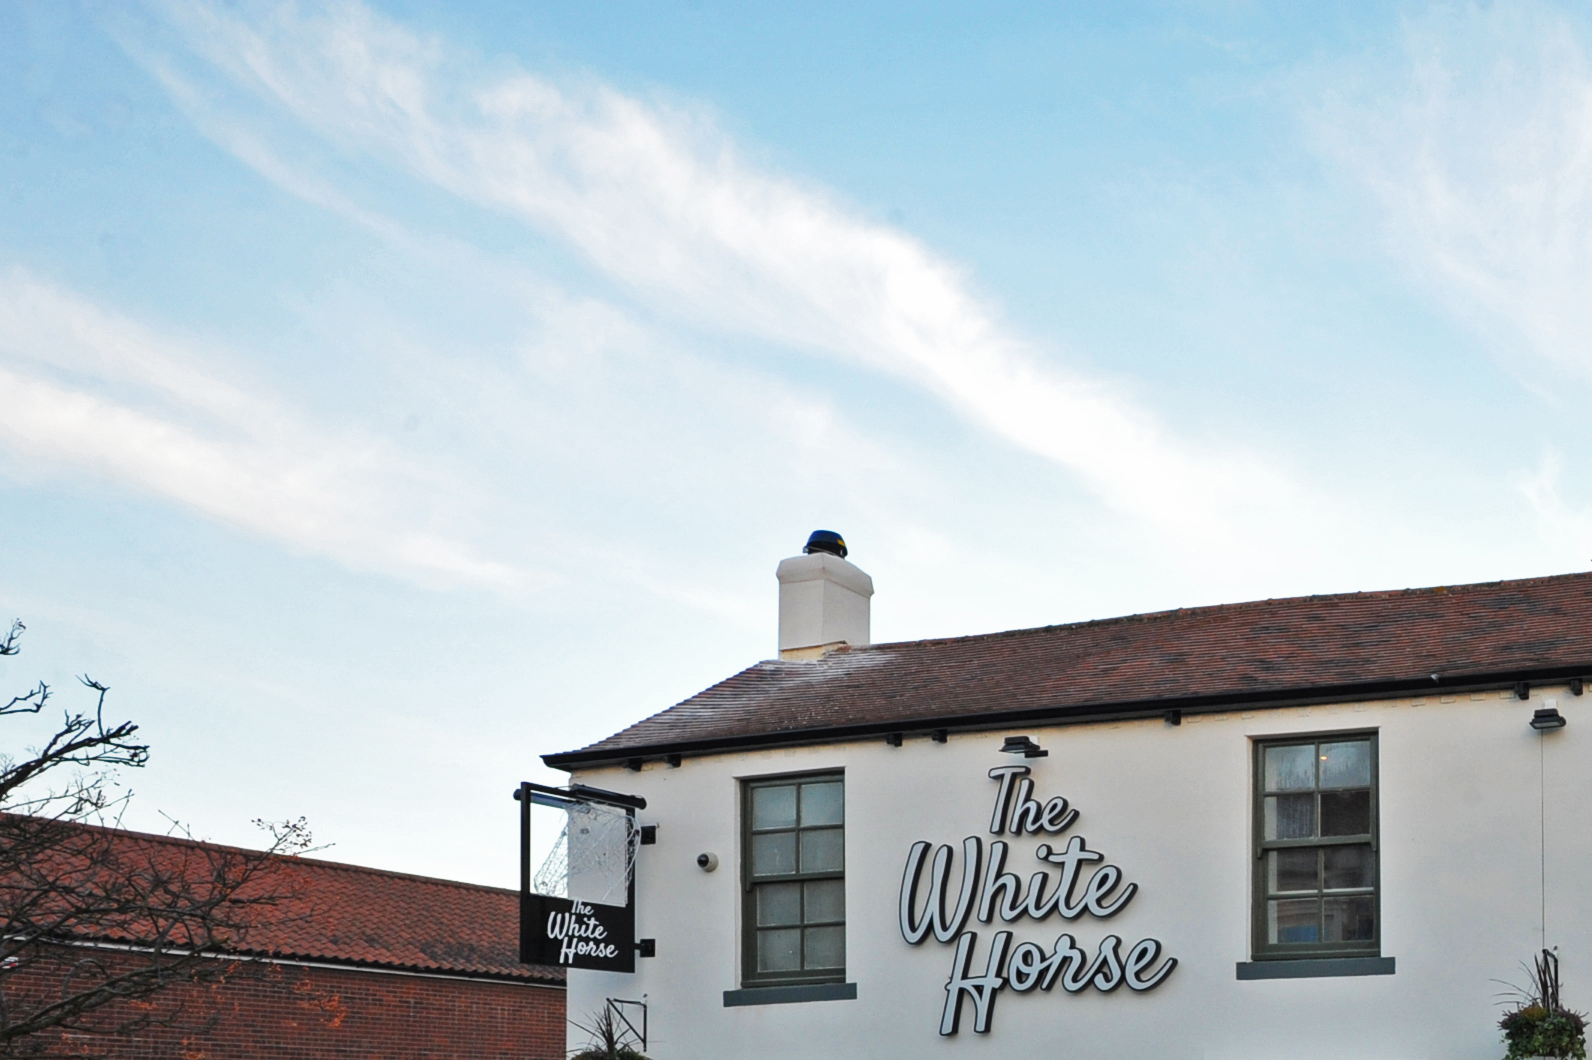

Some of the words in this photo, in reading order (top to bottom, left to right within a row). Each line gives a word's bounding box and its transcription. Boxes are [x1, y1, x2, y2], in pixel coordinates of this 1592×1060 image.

[988, 765, 1080, 836] The
[547, 911, 607, 940] White
[899, 835, 1138, 945] White
[559, 936, 618, 964] Horse
[939, 930, 1178, 1037] Horse
